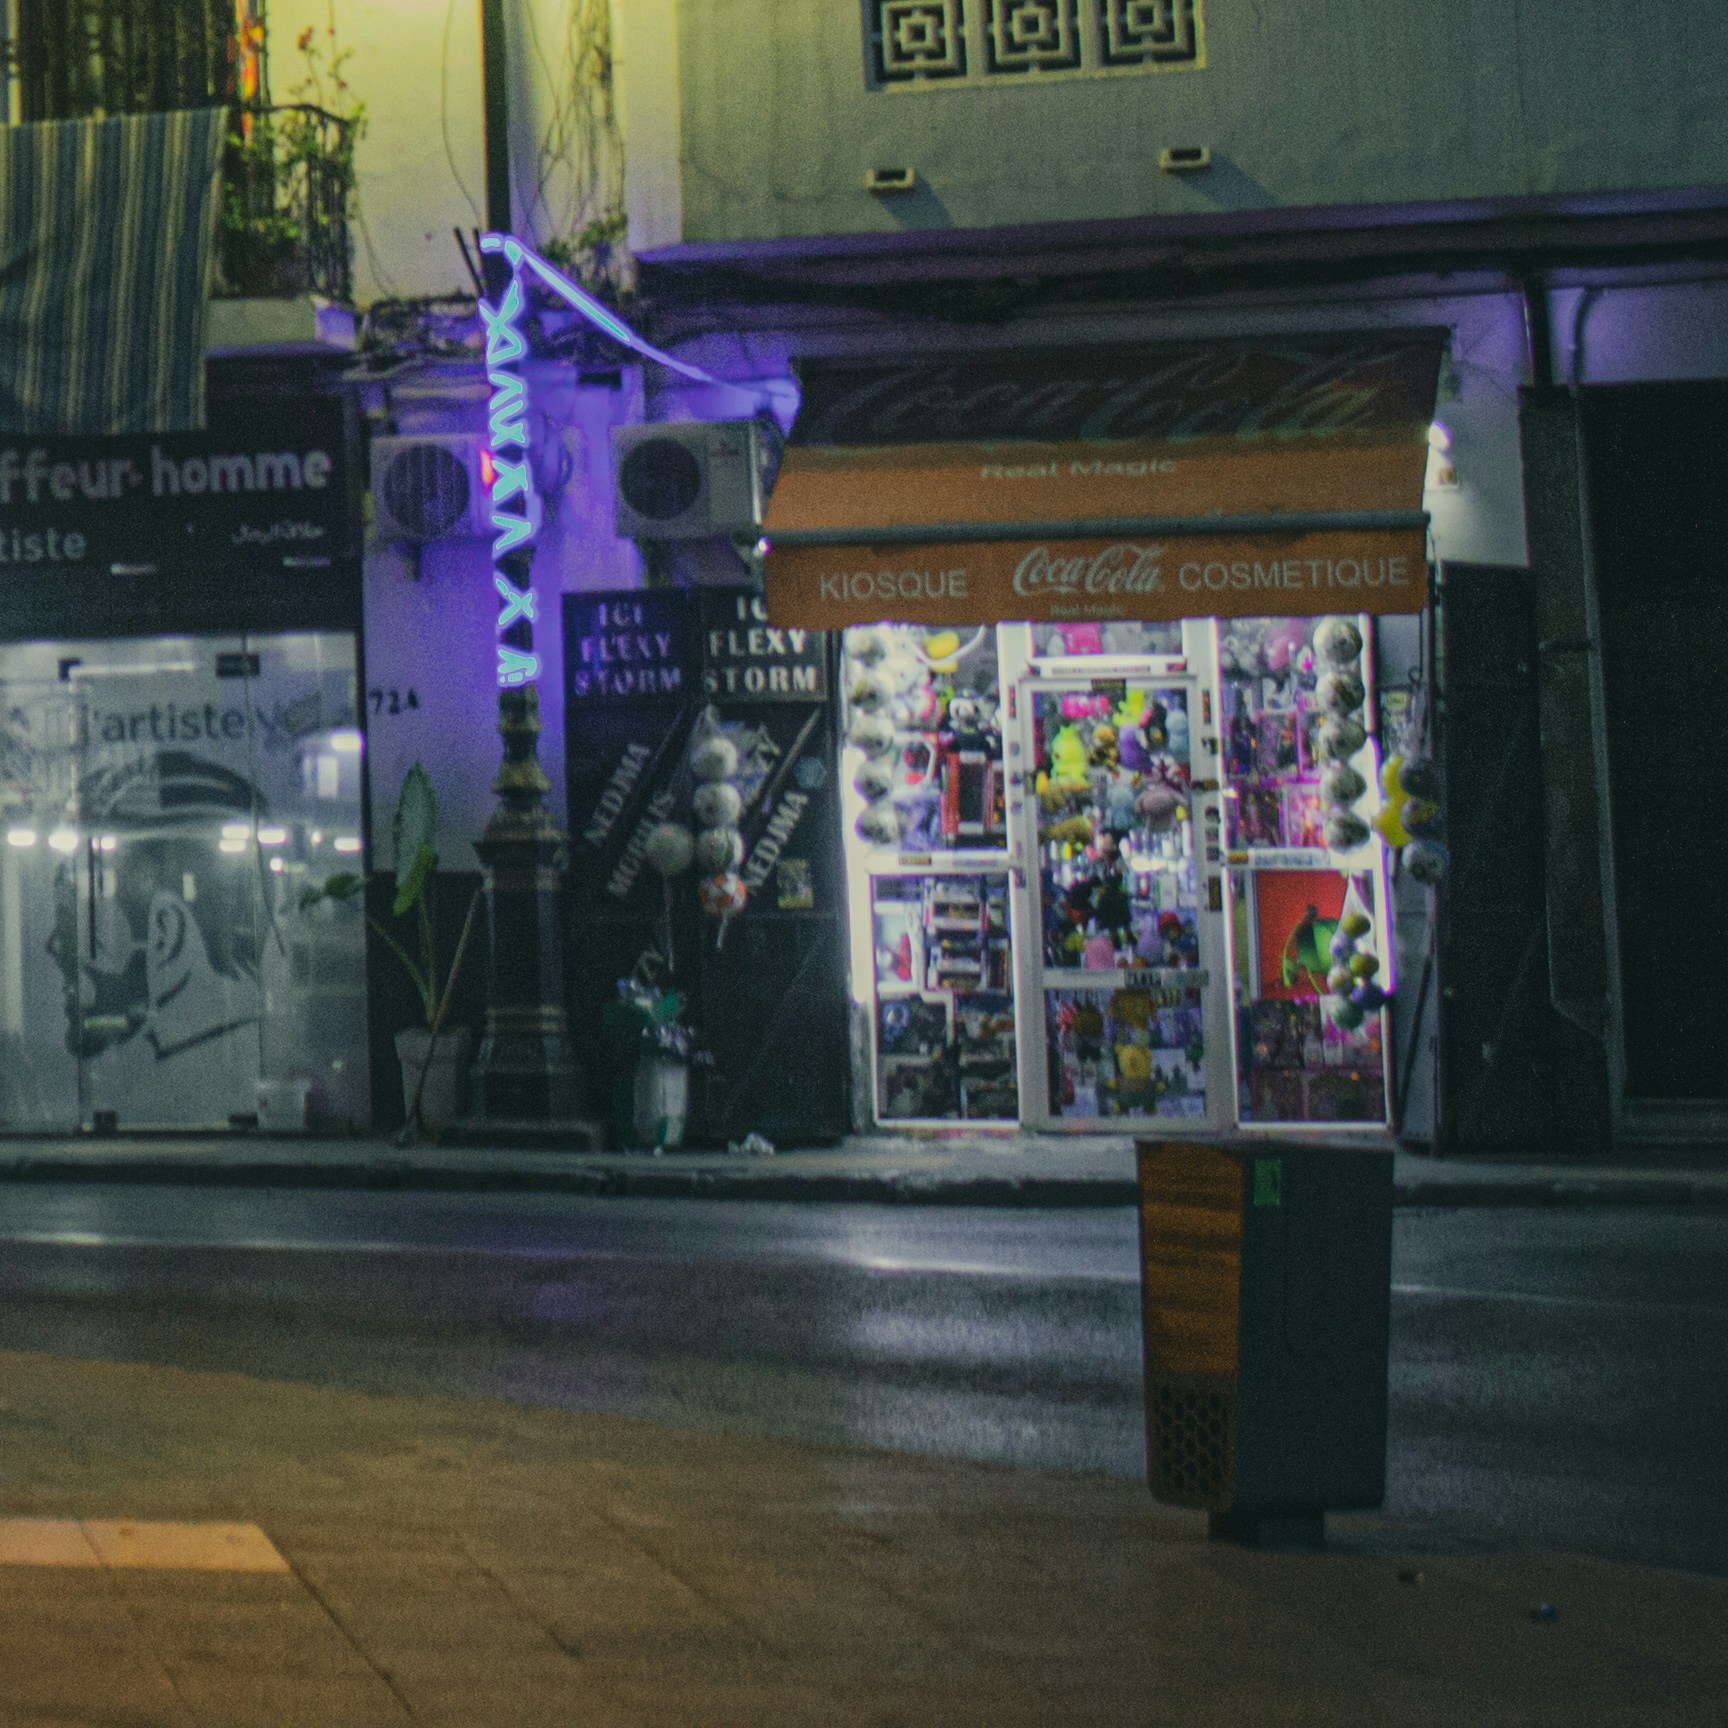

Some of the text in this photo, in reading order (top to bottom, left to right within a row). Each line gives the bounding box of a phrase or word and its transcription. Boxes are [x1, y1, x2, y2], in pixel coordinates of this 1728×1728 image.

[151, 444, 332, 497] homme
[980, 459, 1177, 481] Real Magic
[818, 543, 1410, 602] KIOSQUE Coca-Cola COSMETIQUE
[597, 600, 643, 628] ICI
[735, 594, 768, 622] IC
[580, 630, 671, 663] FLEXY
[709, 627, 808, 657] FLEXY
[573, 665, 682, 698] STORM
[702, 664, 818, 693] STORM
[81, 702, 246, 747] l'artiste
[583, 741, 652, 848] NEDJMA
